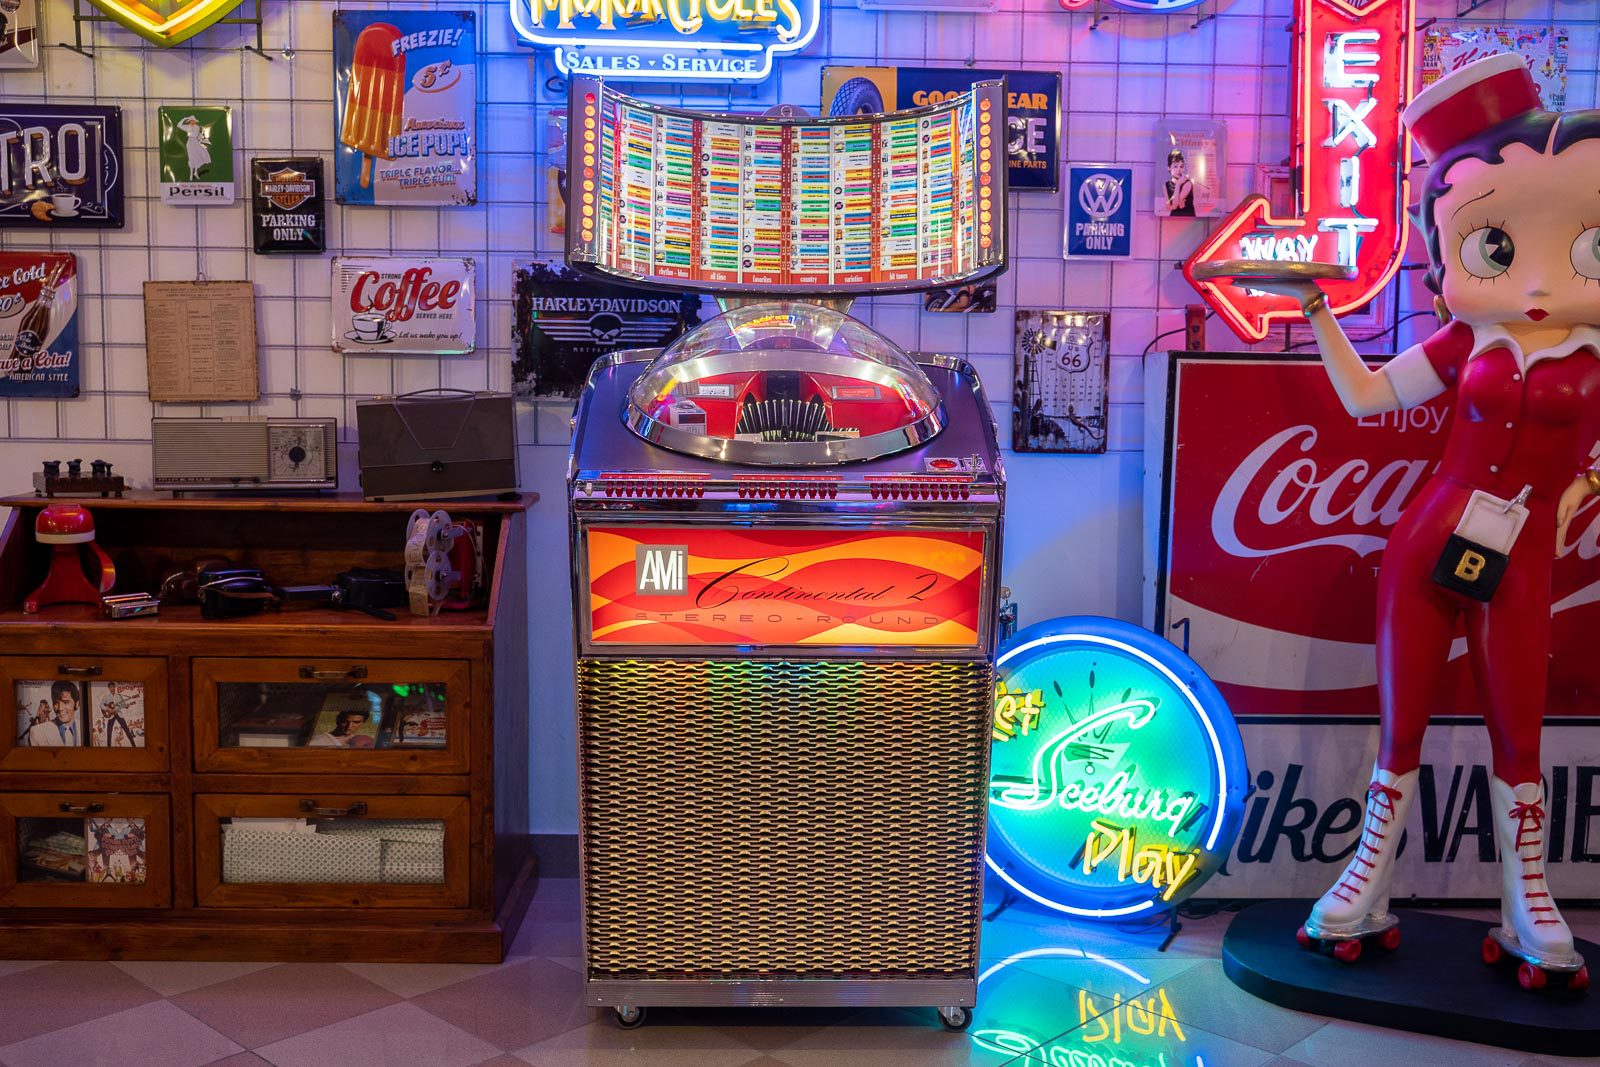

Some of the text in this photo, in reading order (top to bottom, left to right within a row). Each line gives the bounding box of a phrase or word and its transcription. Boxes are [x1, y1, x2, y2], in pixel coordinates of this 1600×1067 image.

[391, 28, 464, 57] FREEZIE!
[912, 90, 1049, 110] GOOEAR
[387, 134, 419, 158] ICE
[1317, 30, 1384, 268] EXIT
[380, 168, 411, 179] TRIPLE
[1023, 161, 1047, 169] PARTS
[169, 186, 225, 197] Persil
[261, 214, 316, 227] PARKING
[1075, 222, 1125, 237] PARKING
[273, 228, 305, 241] ONLY
[1085, 236, 1114, 250] ONLY
[12, 262, 47, 287] Cold
[350, 267, 461, 323] Coffee
[531, 297, 683, 314] HARLEY-DAVIDSON
[398, 331, 409, 339] Let
[437, 333, 449, 341] you
[33, 350, 72, 370] Cola!
[1061, 352, 1082, 368] 66
[1454, 549, 1486, 583] B
[695, 556, 939, 611] Continental 2
[1079, 819, 1201, 902] Play
